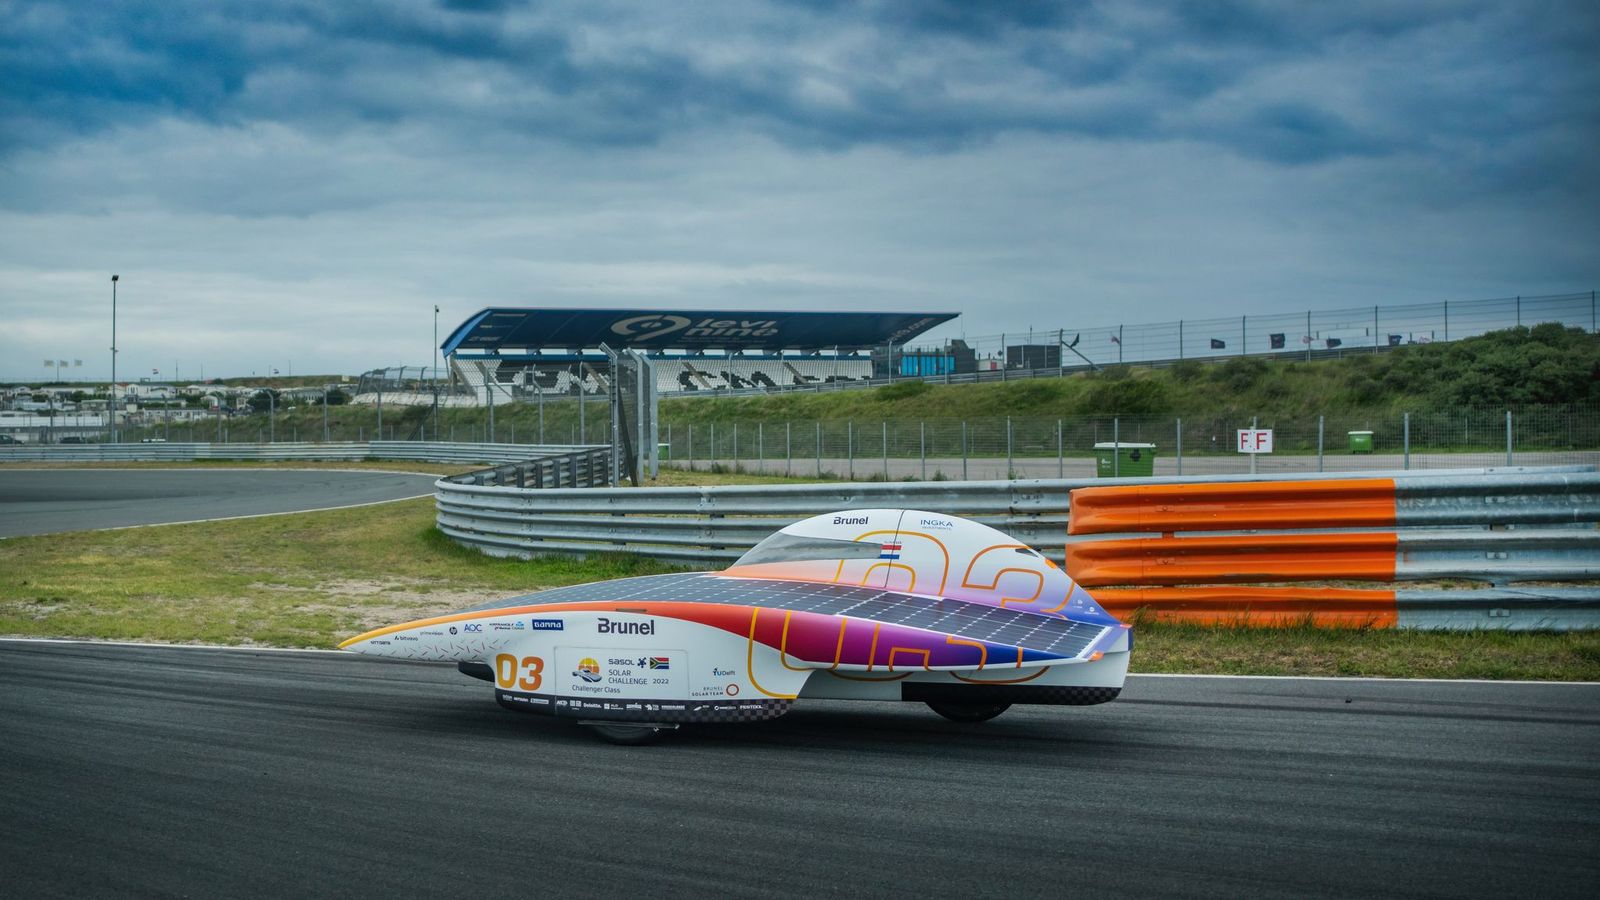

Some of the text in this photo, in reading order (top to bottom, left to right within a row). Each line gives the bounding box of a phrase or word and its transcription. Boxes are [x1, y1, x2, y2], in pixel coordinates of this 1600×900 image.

[833, 516, 869, 525] Brunel
[920, 519, 953, 527] INGKA
[464, 623, 482, 632] AOC
[597, 618, 655, 635] Brunel
[496, 653, 544, 691] 03
[608, 677, 648, 685] CHALLENGE
[572, 684, 603, 693] Challenger
